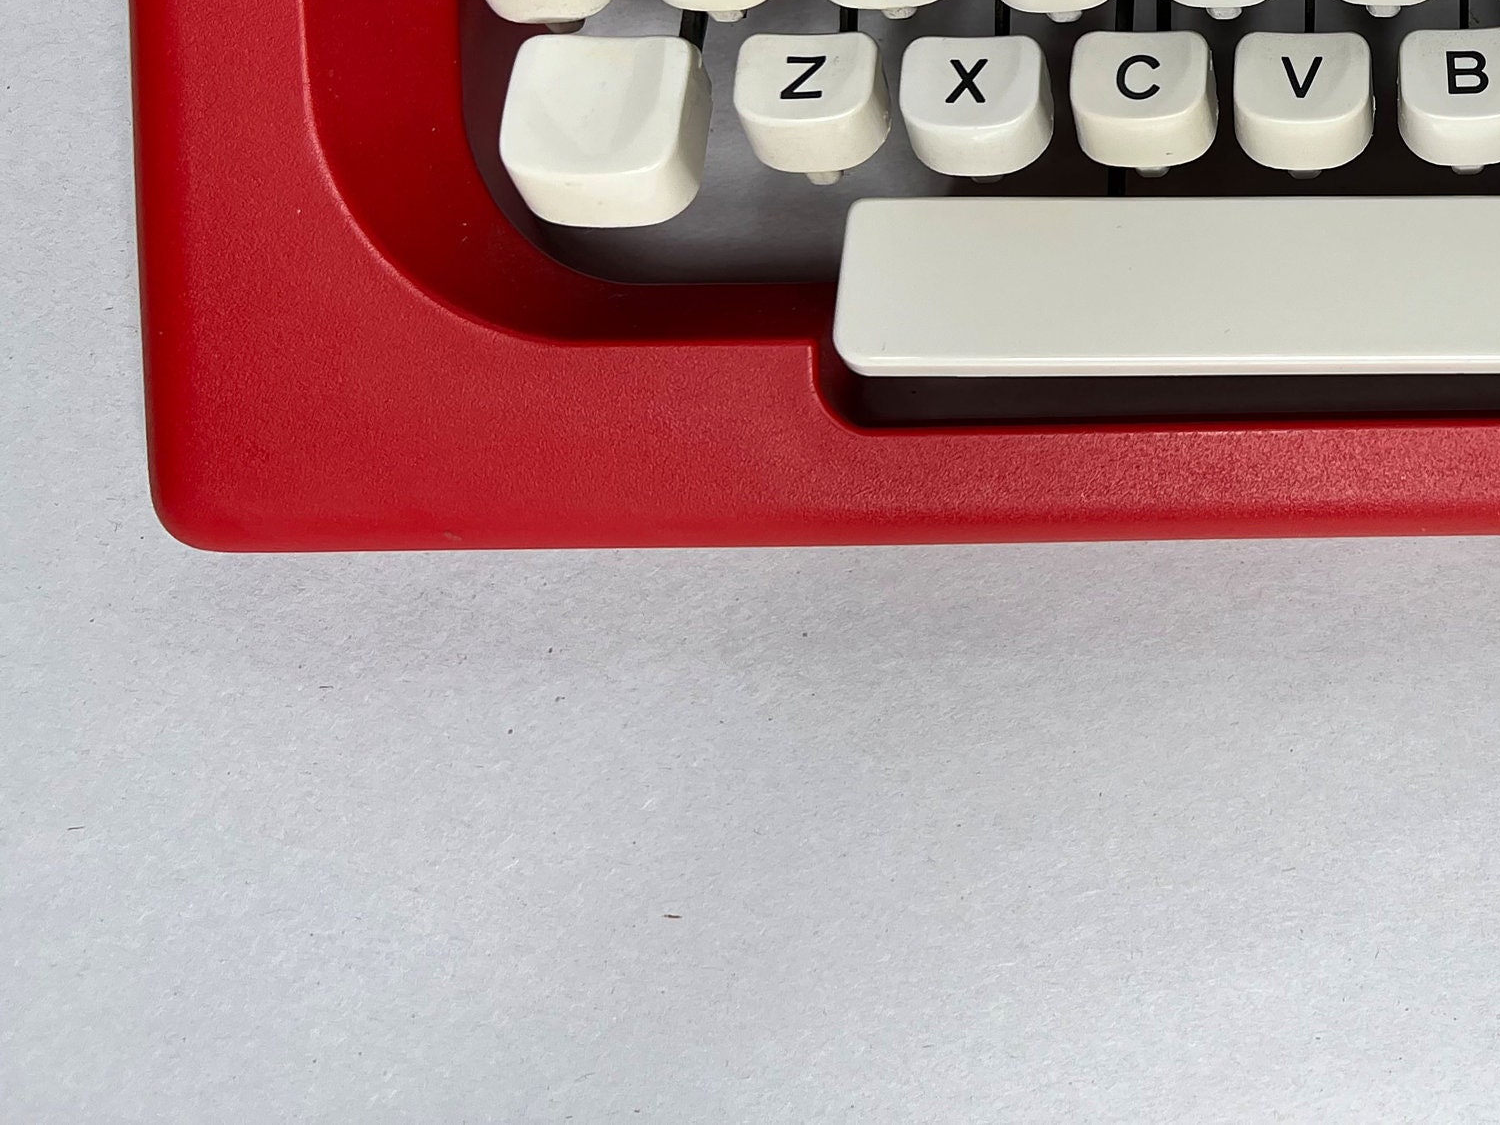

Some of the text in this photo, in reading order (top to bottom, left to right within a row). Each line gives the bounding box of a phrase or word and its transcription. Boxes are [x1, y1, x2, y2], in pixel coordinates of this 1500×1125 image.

[779, 55, 827, 100] Z
[944, 58, 989, 104] X
[1115, 54, 1161, 101] C
[1280, 56, 1324, 99] V
[1445, 50, 1490, 95] B
